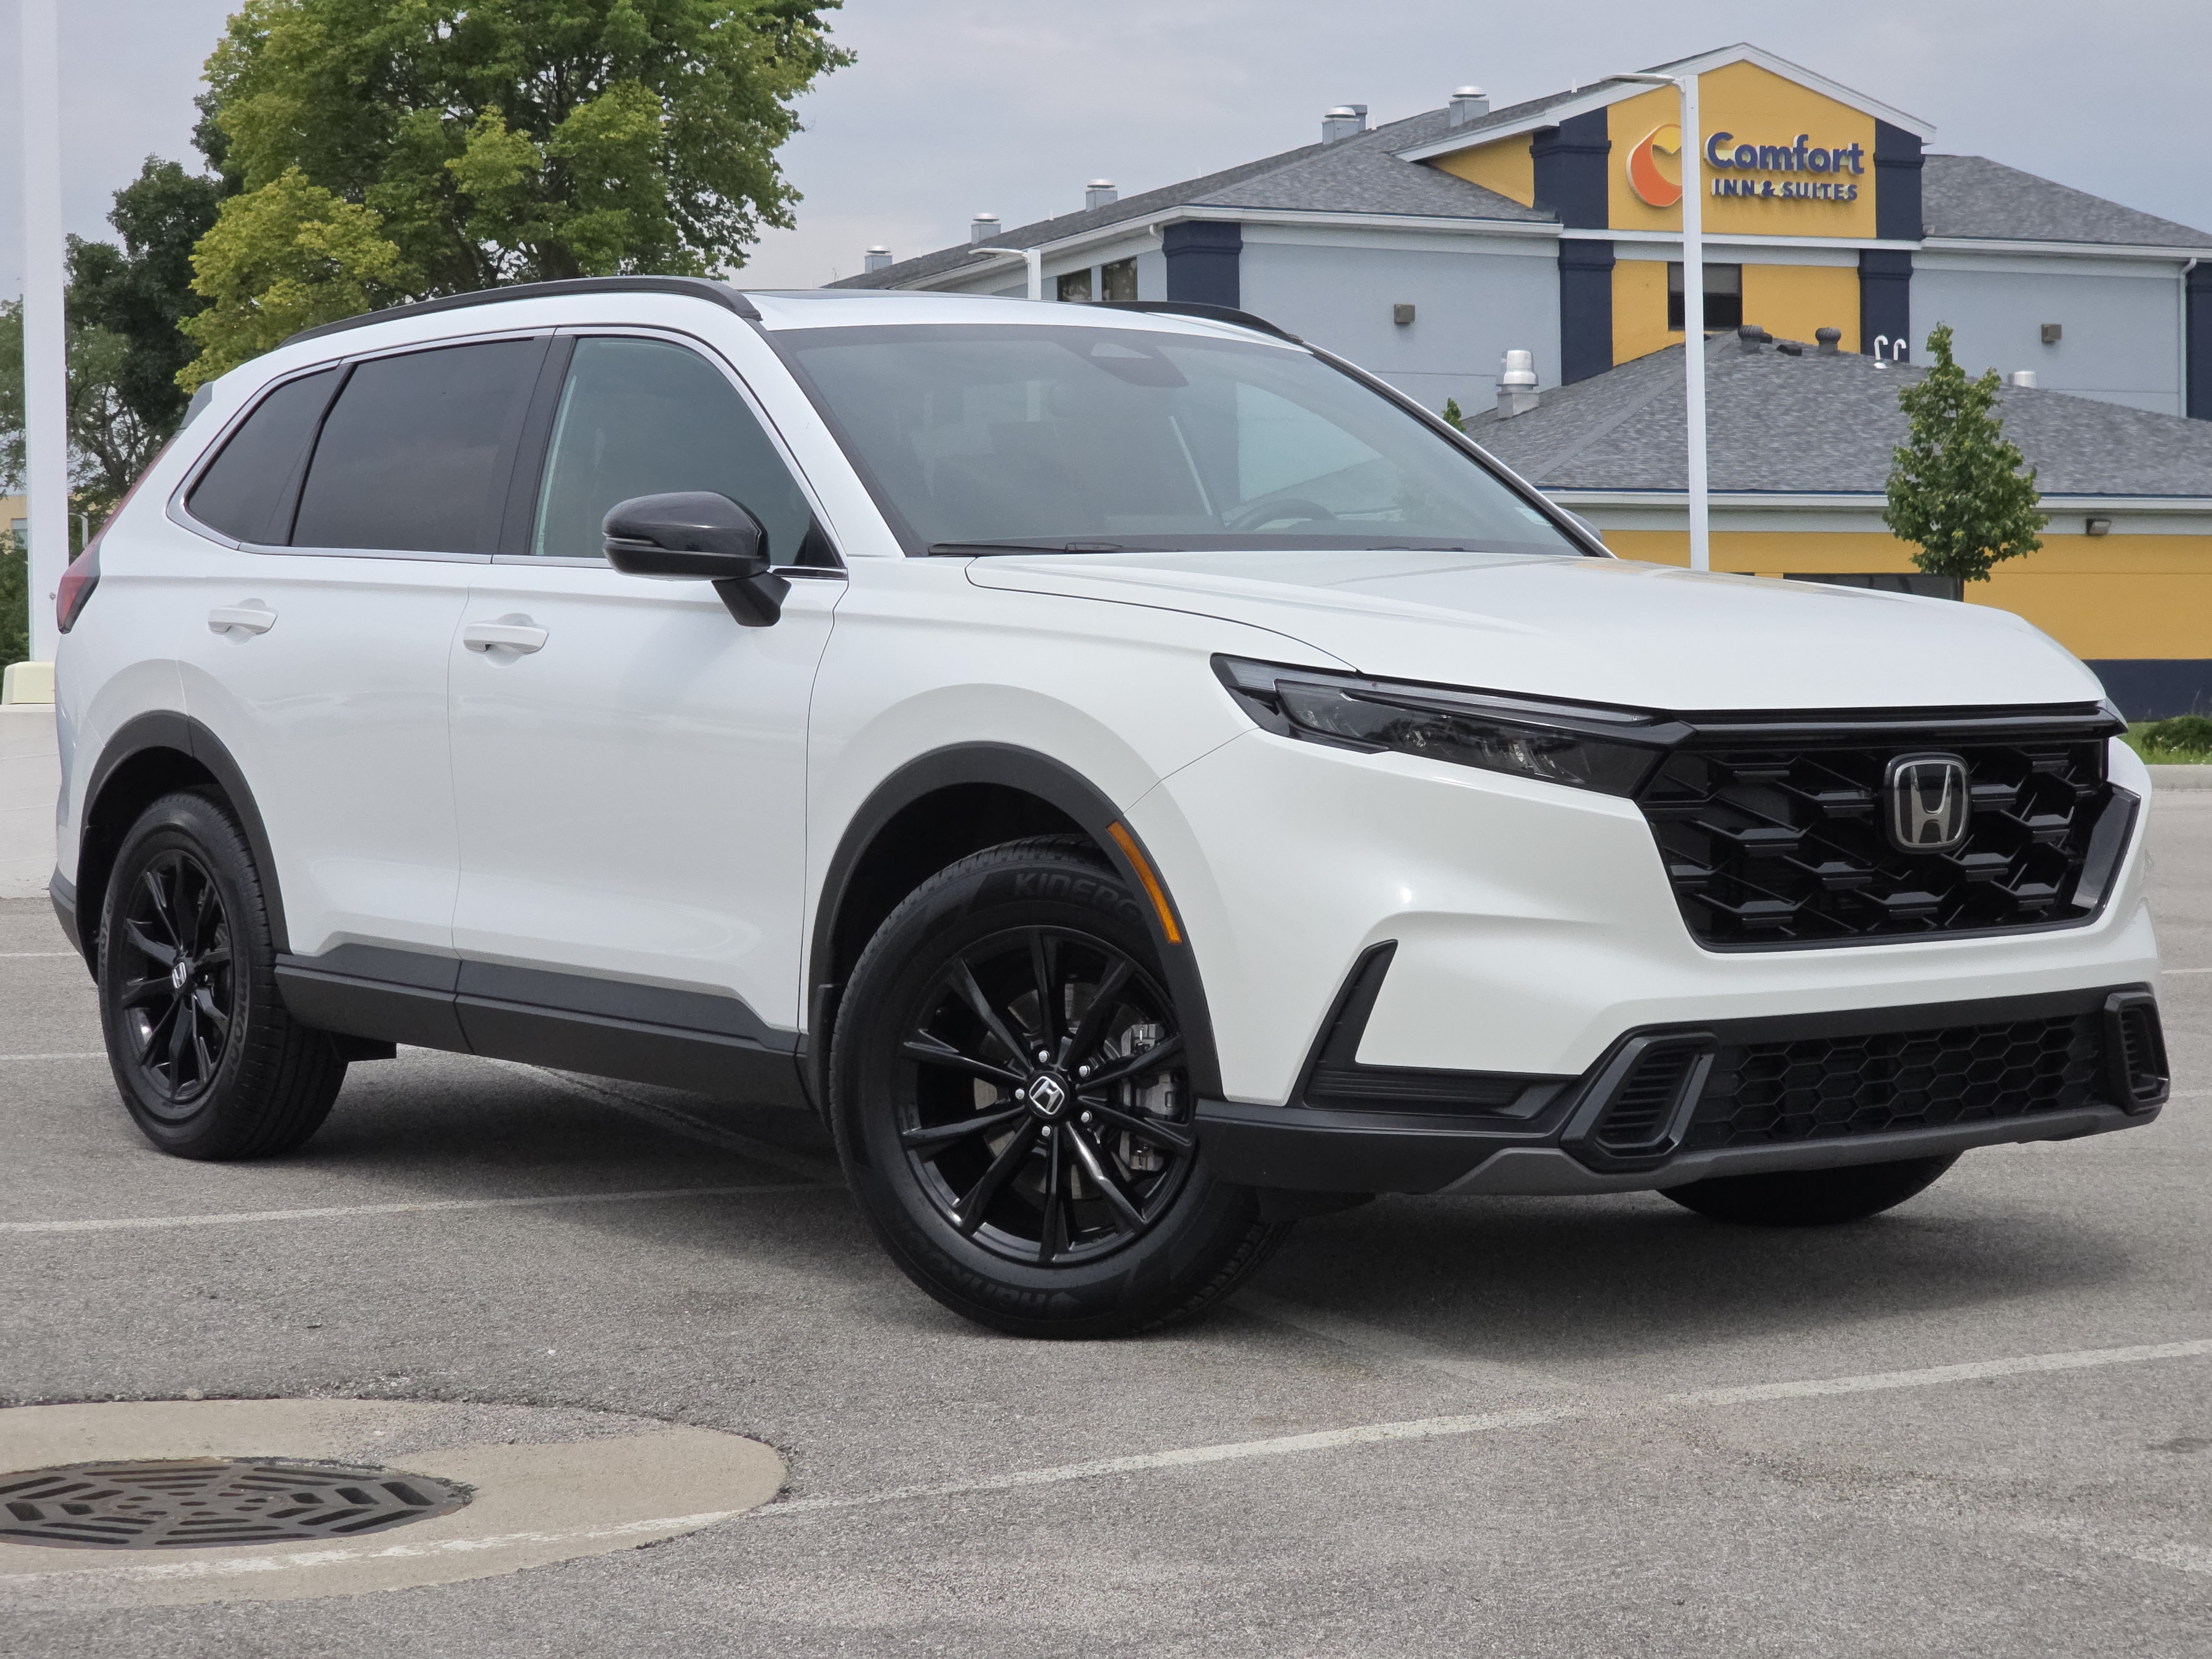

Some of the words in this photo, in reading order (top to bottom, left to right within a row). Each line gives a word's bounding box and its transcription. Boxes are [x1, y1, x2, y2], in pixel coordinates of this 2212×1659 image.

[1705, 132, 1865, 174] Comfort
[1712, 178, 1755, 196] INN
[1760, 180, 1776, 197] &
[1780, 181, 1858, 201] SUITES
